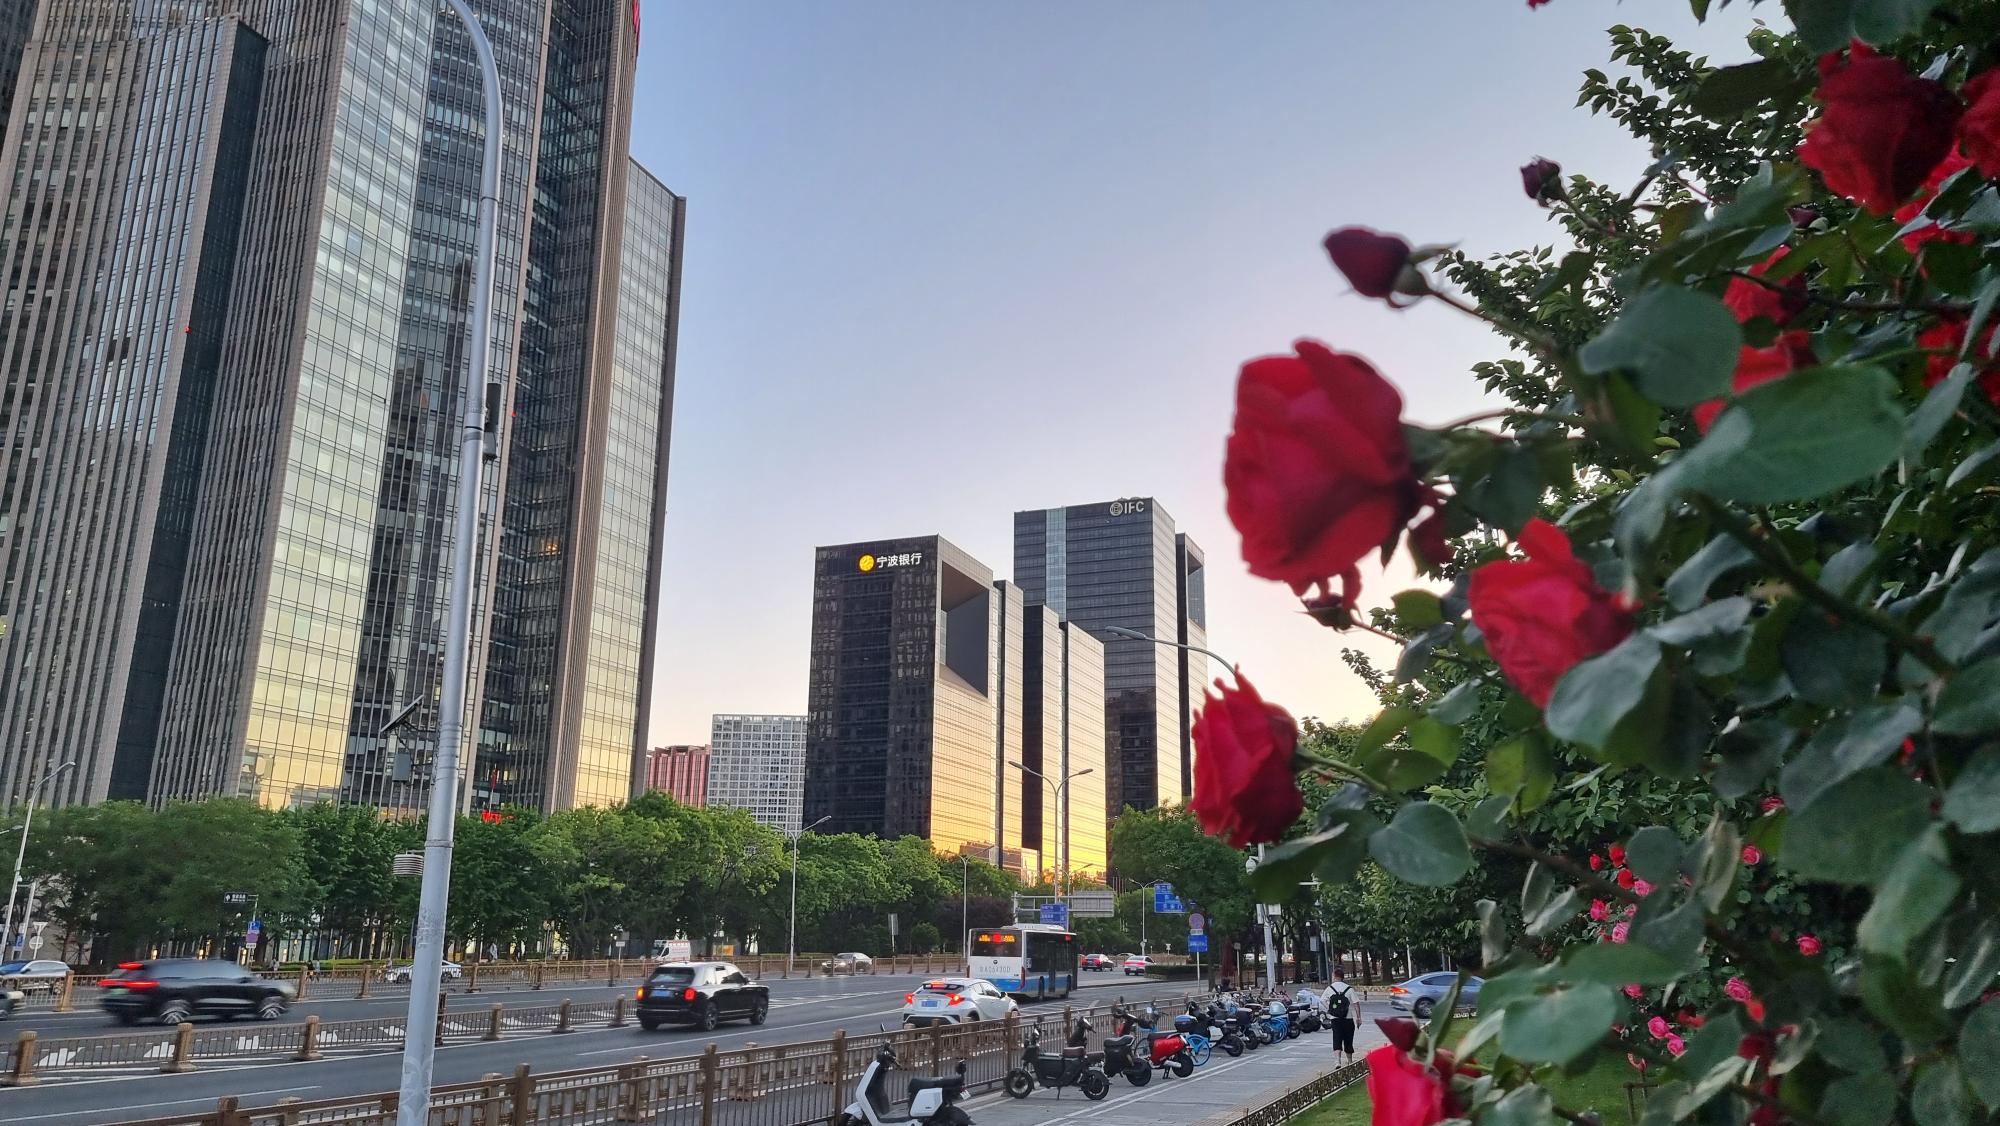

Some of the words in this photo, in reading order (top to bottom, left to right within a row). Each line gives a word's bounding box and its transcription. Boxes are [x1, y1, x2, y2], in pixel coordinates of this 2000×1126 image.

[1124, 501, 1145, 514] IFC
[876, 553, 922, 568] 宁波银行
